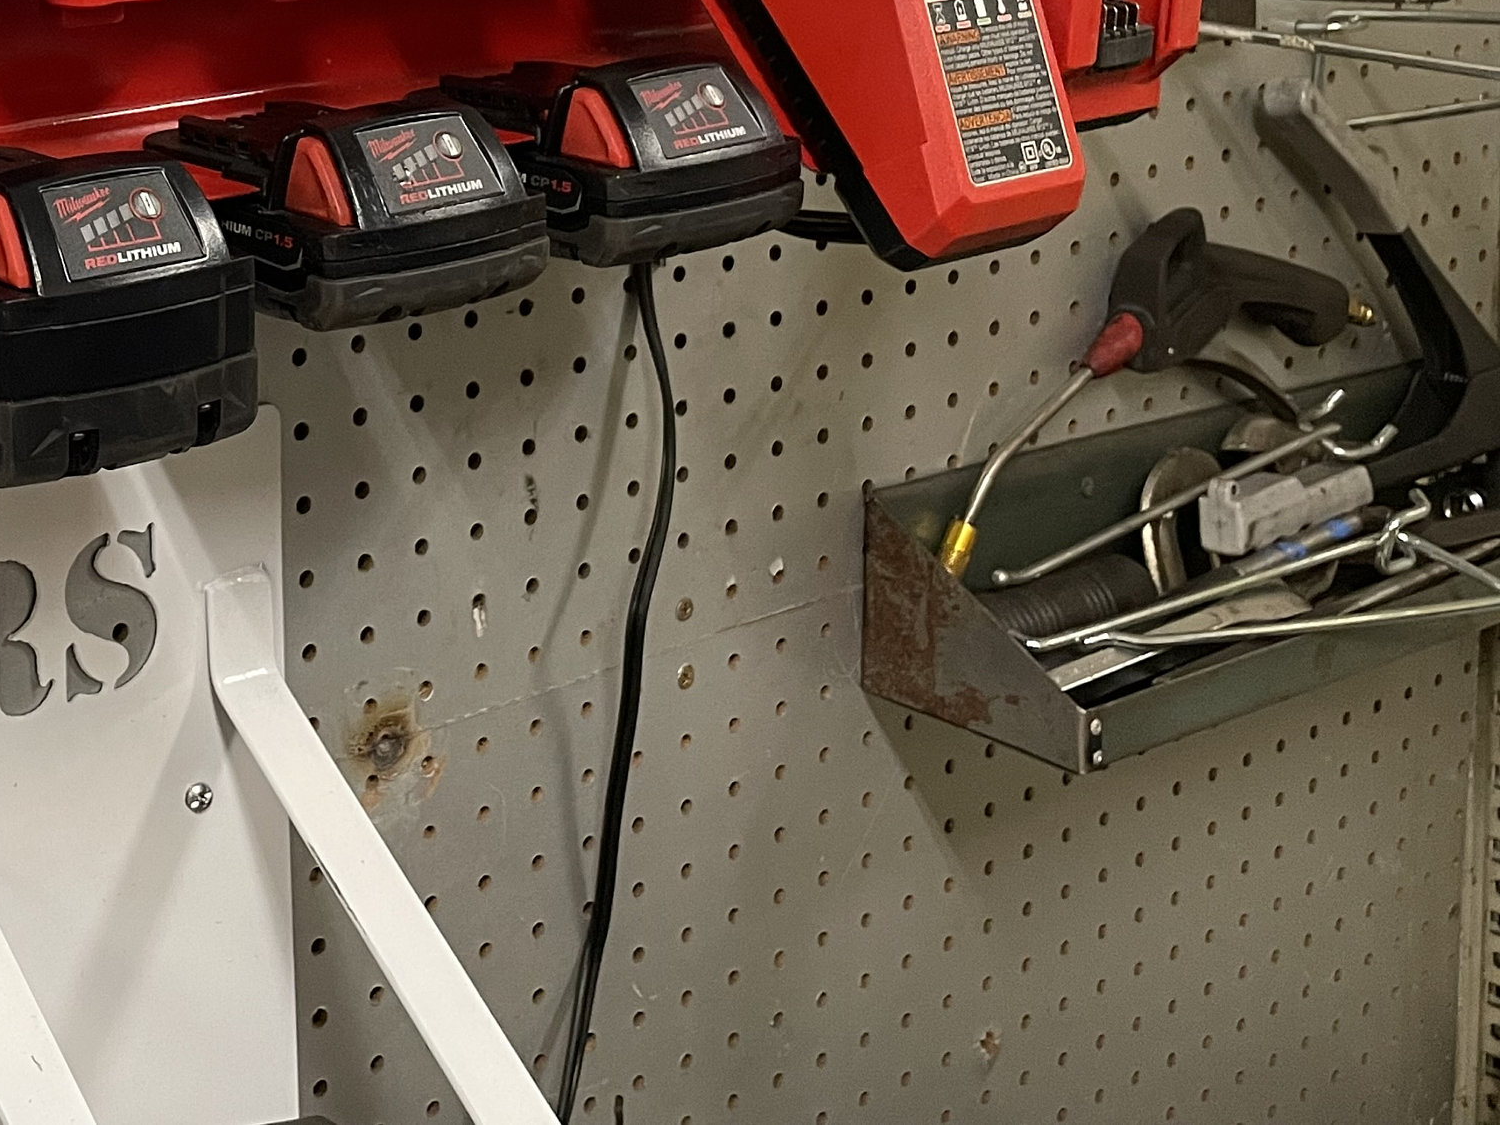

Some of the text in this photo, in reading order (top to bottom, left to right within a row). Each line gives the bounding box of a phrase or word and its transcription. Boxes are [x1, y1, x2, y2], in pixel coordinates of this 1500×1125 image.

[399, 178, 484, 205] REDLITHIUM
[255, 229, 294, 249] CP1.5
[84, 241, 182, 270] REDLITHIUM
